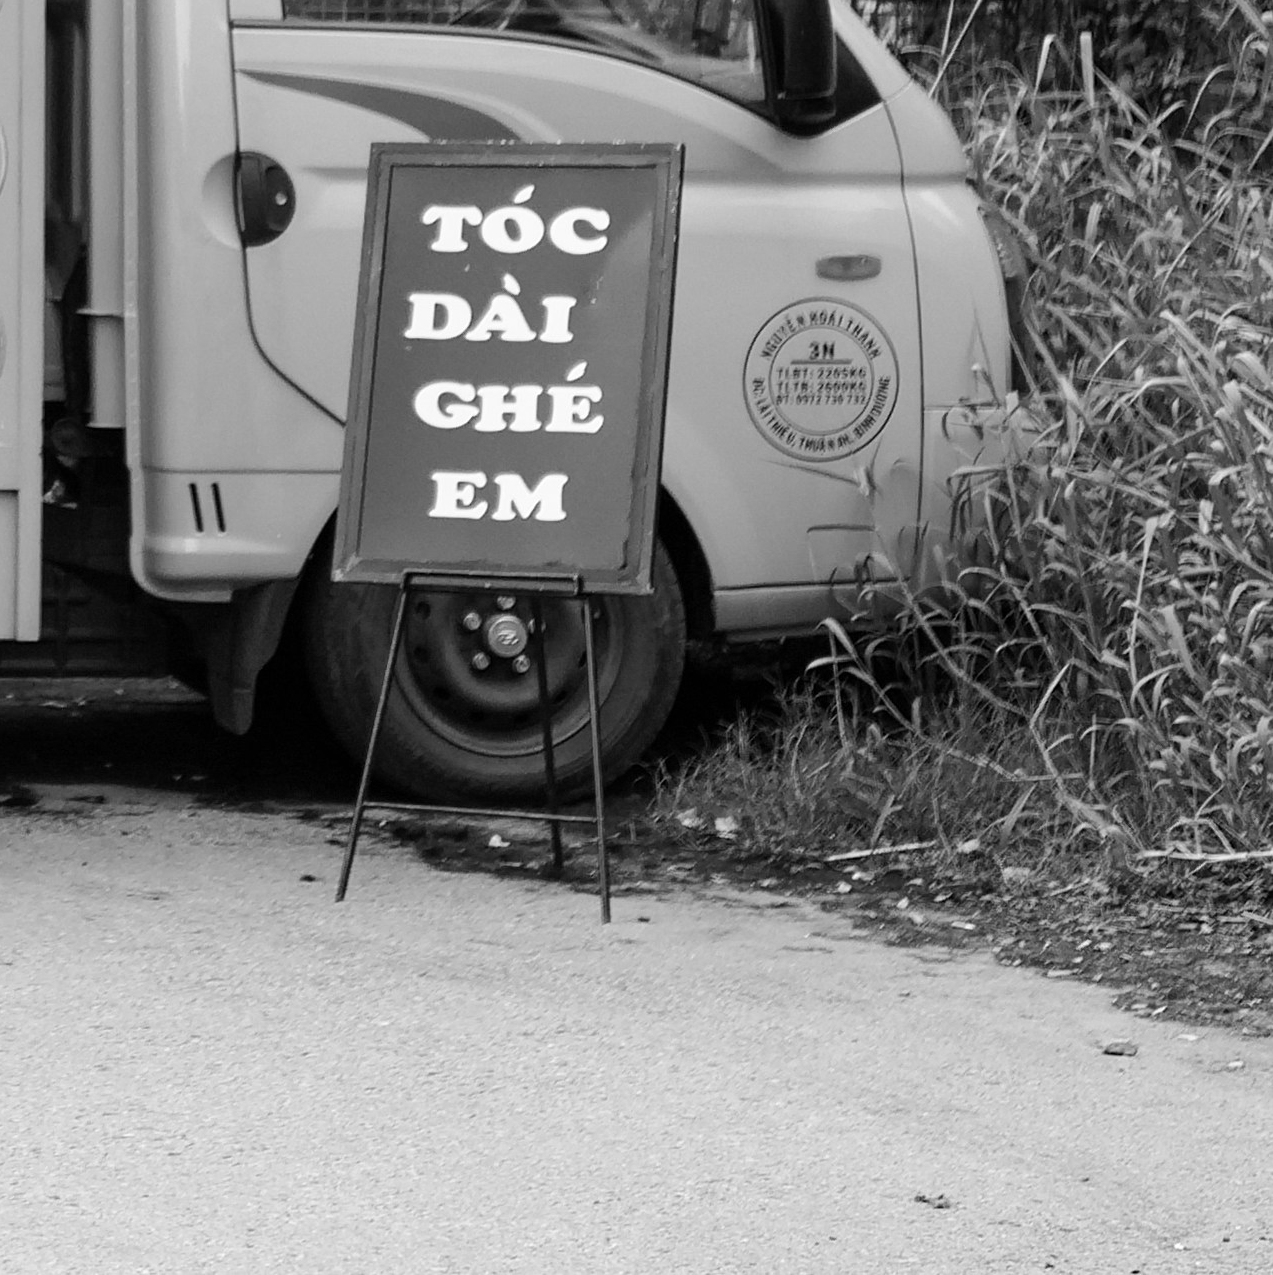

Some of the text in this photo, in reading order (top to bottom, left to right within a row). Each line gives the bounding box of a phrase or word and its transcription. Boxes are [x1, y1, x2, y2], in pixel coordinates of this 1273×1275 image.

[422, 184, 611, 255] TÓC
[404, 273, 578, 343] DÀI
[808, 341, 836, 360] 3N
[414, 361, 605, 434] GHÉ
[428, 472, 569, 523] EM
